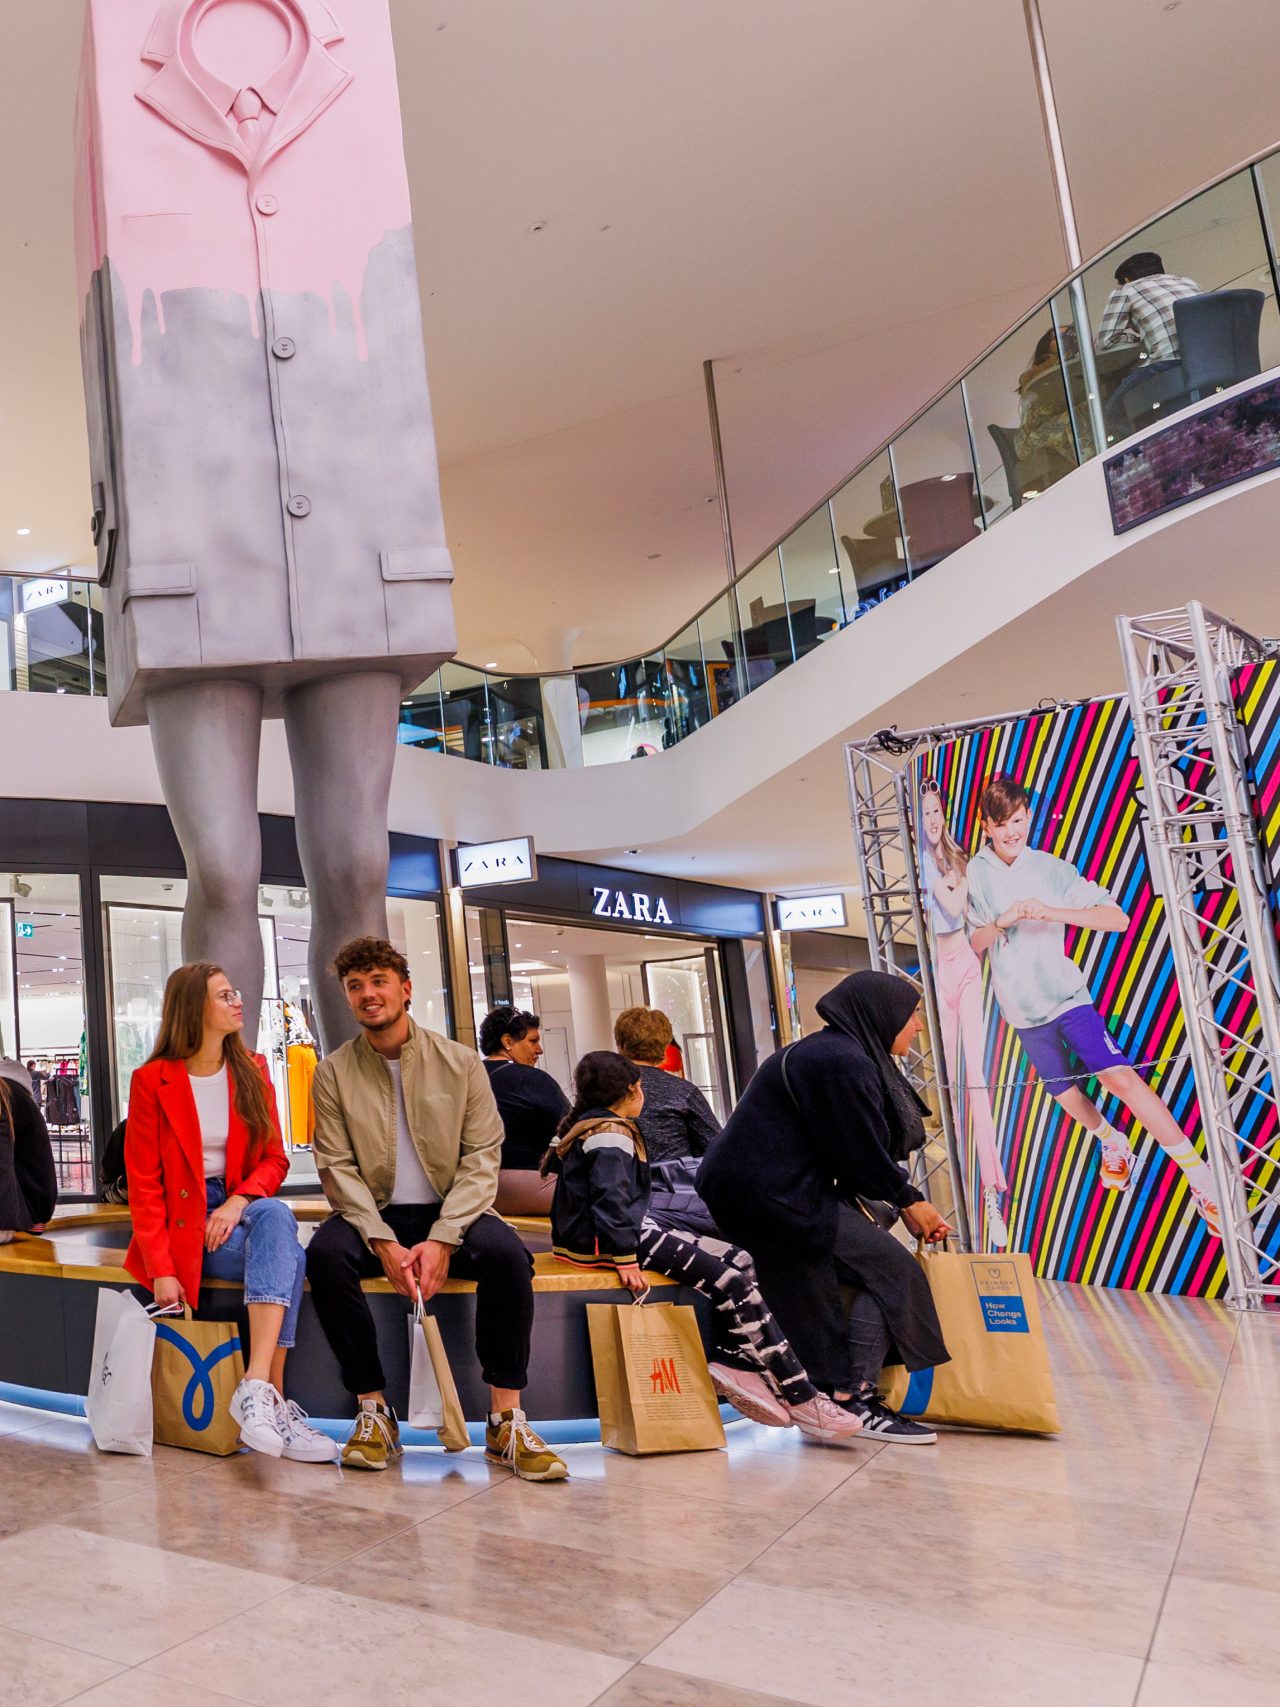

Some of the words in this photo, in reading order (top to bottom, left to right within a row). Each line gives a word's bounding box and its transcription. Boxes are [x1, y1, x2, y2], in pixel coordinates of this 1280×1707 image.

[26, 583, 64, 601] ZARA
[464, 855, 524, 872] ZARA
[593, 886, 673, 925] ZARA
[784, 907, 838, 919] ZARA
[987, 1310, 1022, 1319] Change
[989, 1318, 1018, 1326] Looks
